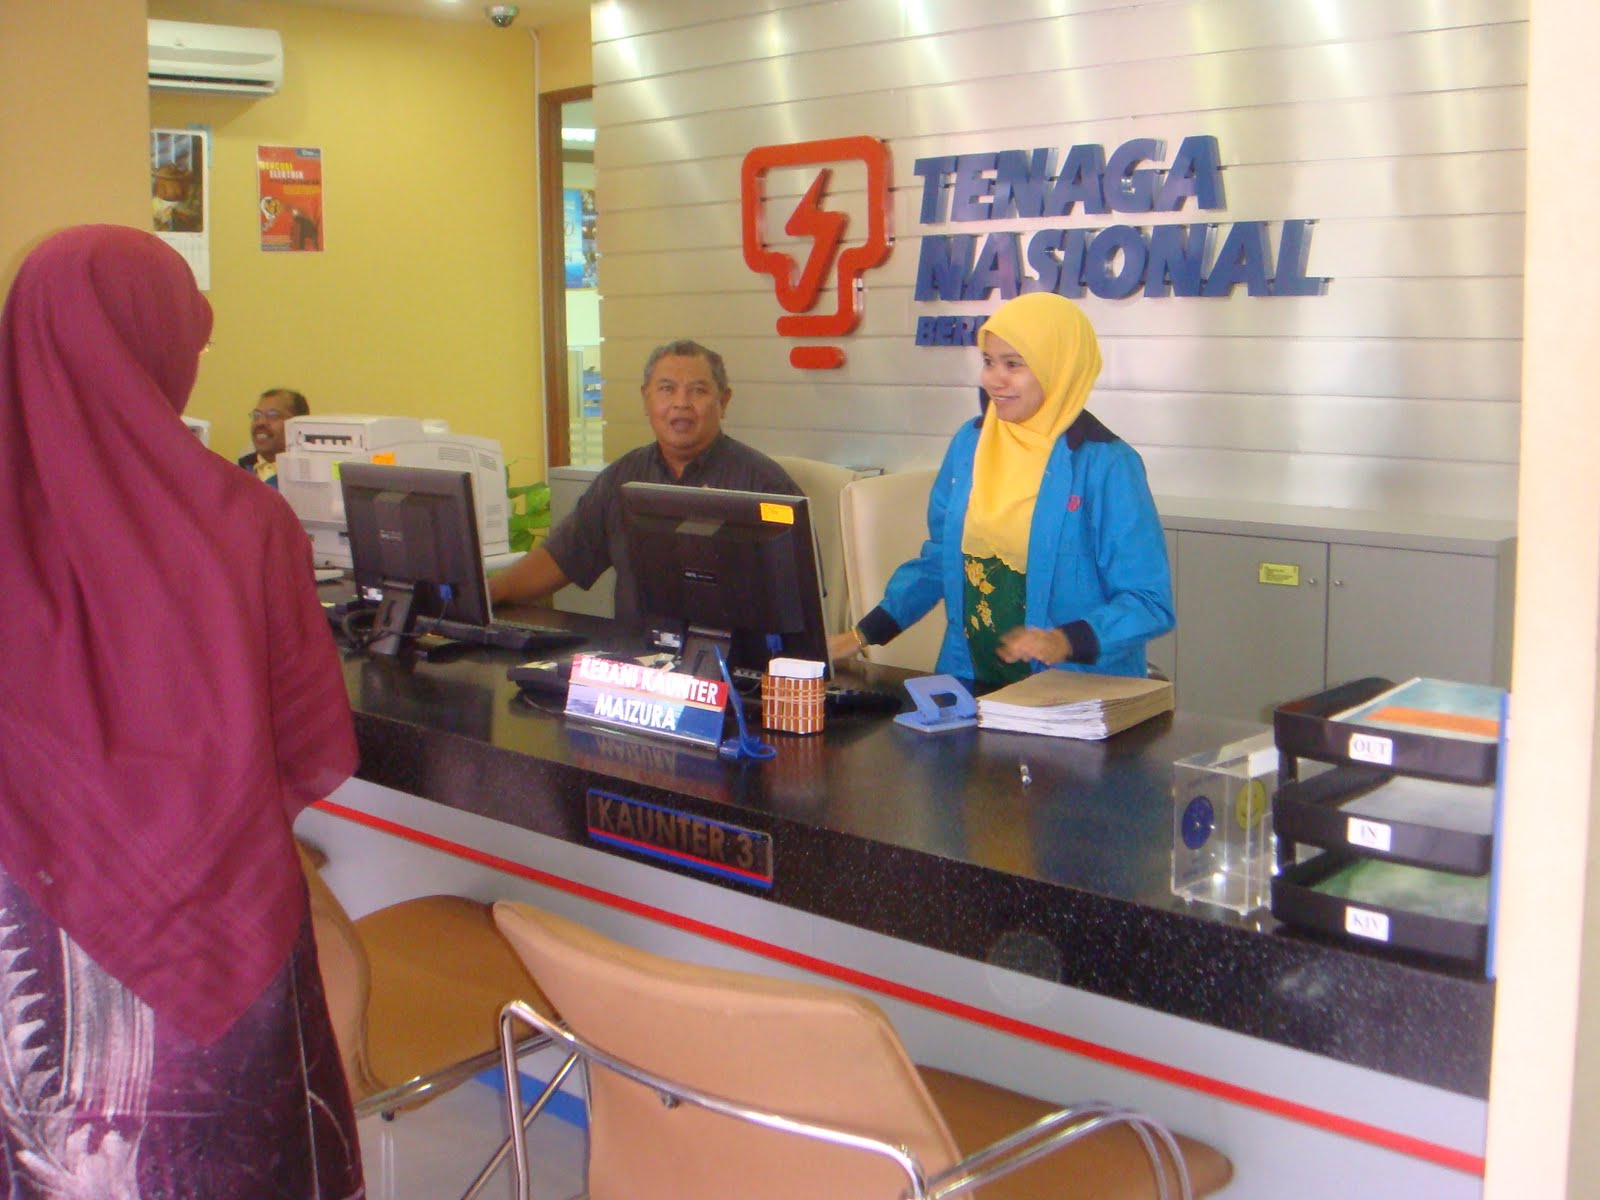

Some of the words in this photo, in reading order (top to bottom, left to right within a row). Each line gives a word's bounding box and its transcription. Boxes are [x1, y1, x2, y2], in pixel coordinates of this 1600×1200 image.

[914, 135, 1227, 224] TENAGA
[914, 219, 1329, 301] NASIONAL
[915, 315, 991, 346] BER
[640, 671, 719, 705] KAUNTER
[594, 693, 677, 731] MAIZURA
[1354, 739, 1387, 756] OUT
[597, 797, 726, 861] KAUNTER
[736, 833, 755, 869] 3
